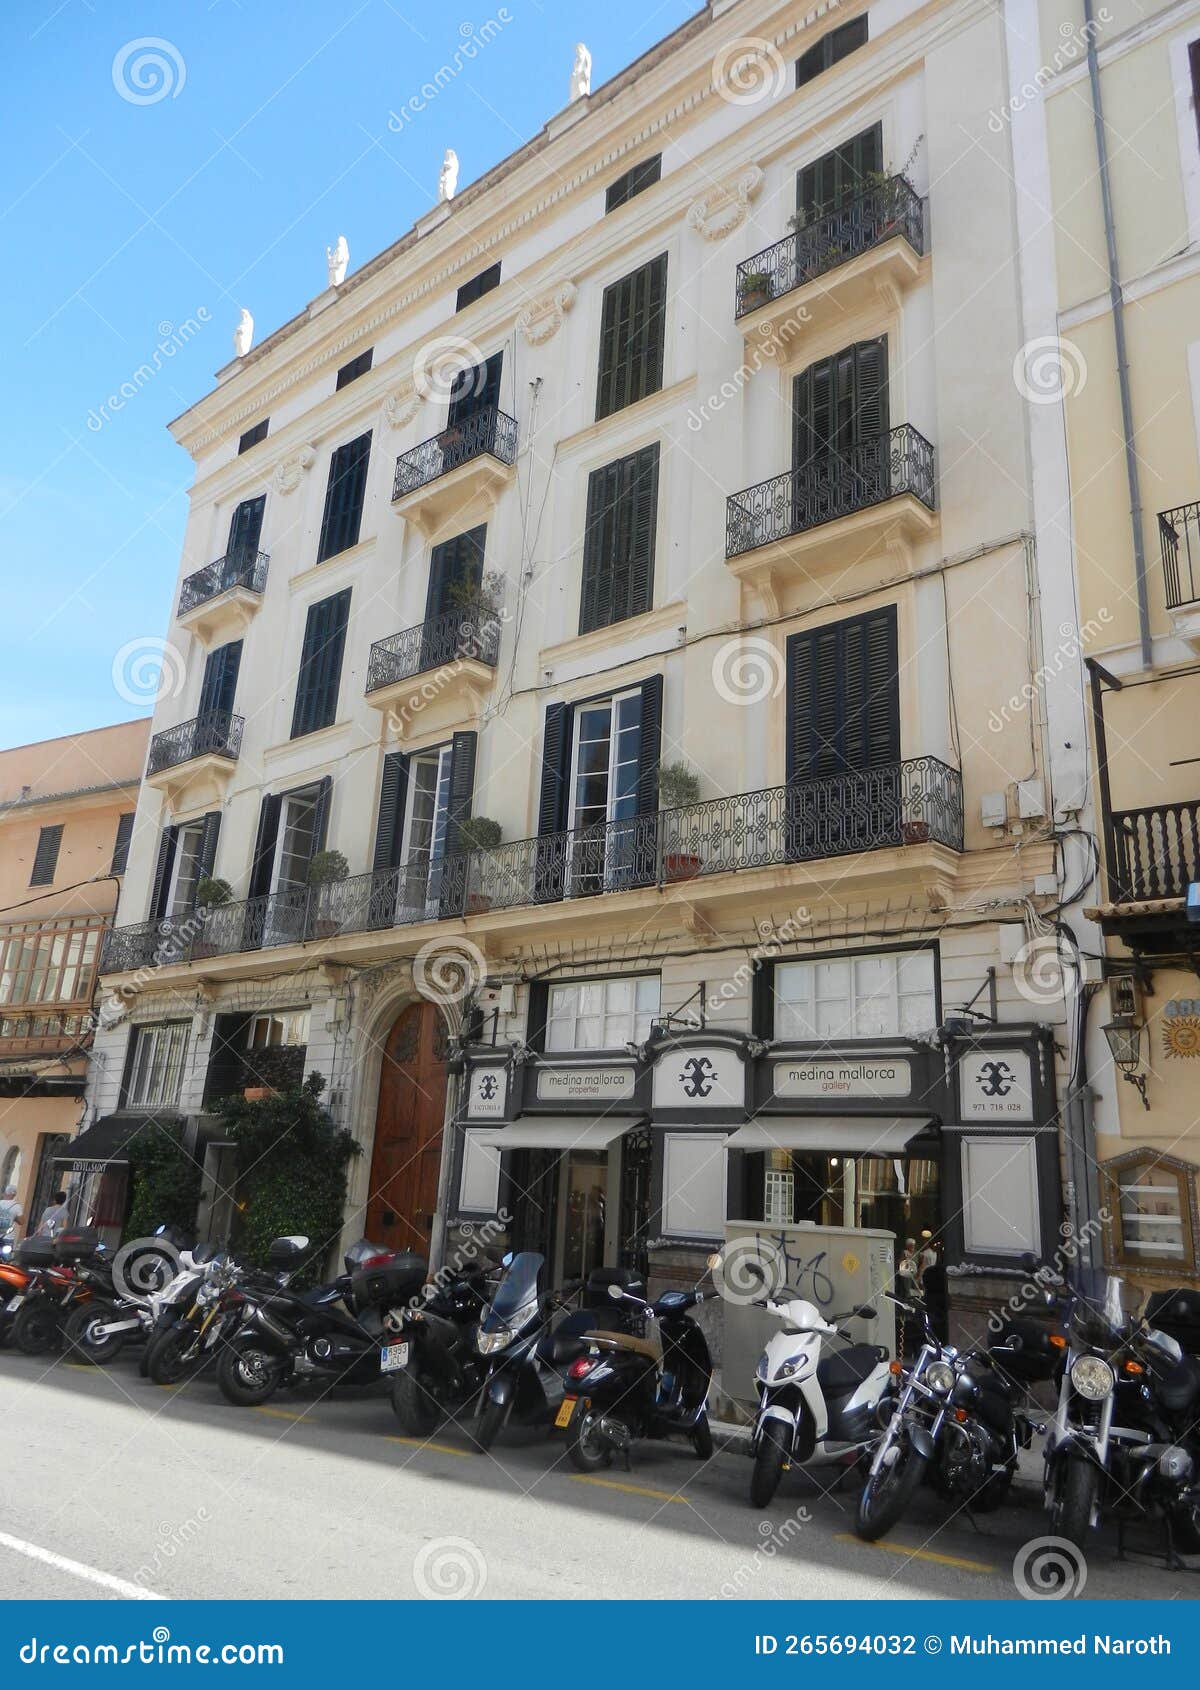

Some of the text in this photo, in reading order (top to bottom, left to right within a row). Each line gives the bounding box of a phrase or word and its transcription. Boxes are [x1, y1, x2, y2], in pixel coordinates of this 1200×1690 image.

[789, 1064, 896, 1081] medina mallorca
[550, 1073, 625, 1086] medina mallorca
[568, 1085, 599, 1095] properties
[822, 1080, 851, 1091] gallery
[973, 1103, 1022, 1112] 971 718 028
